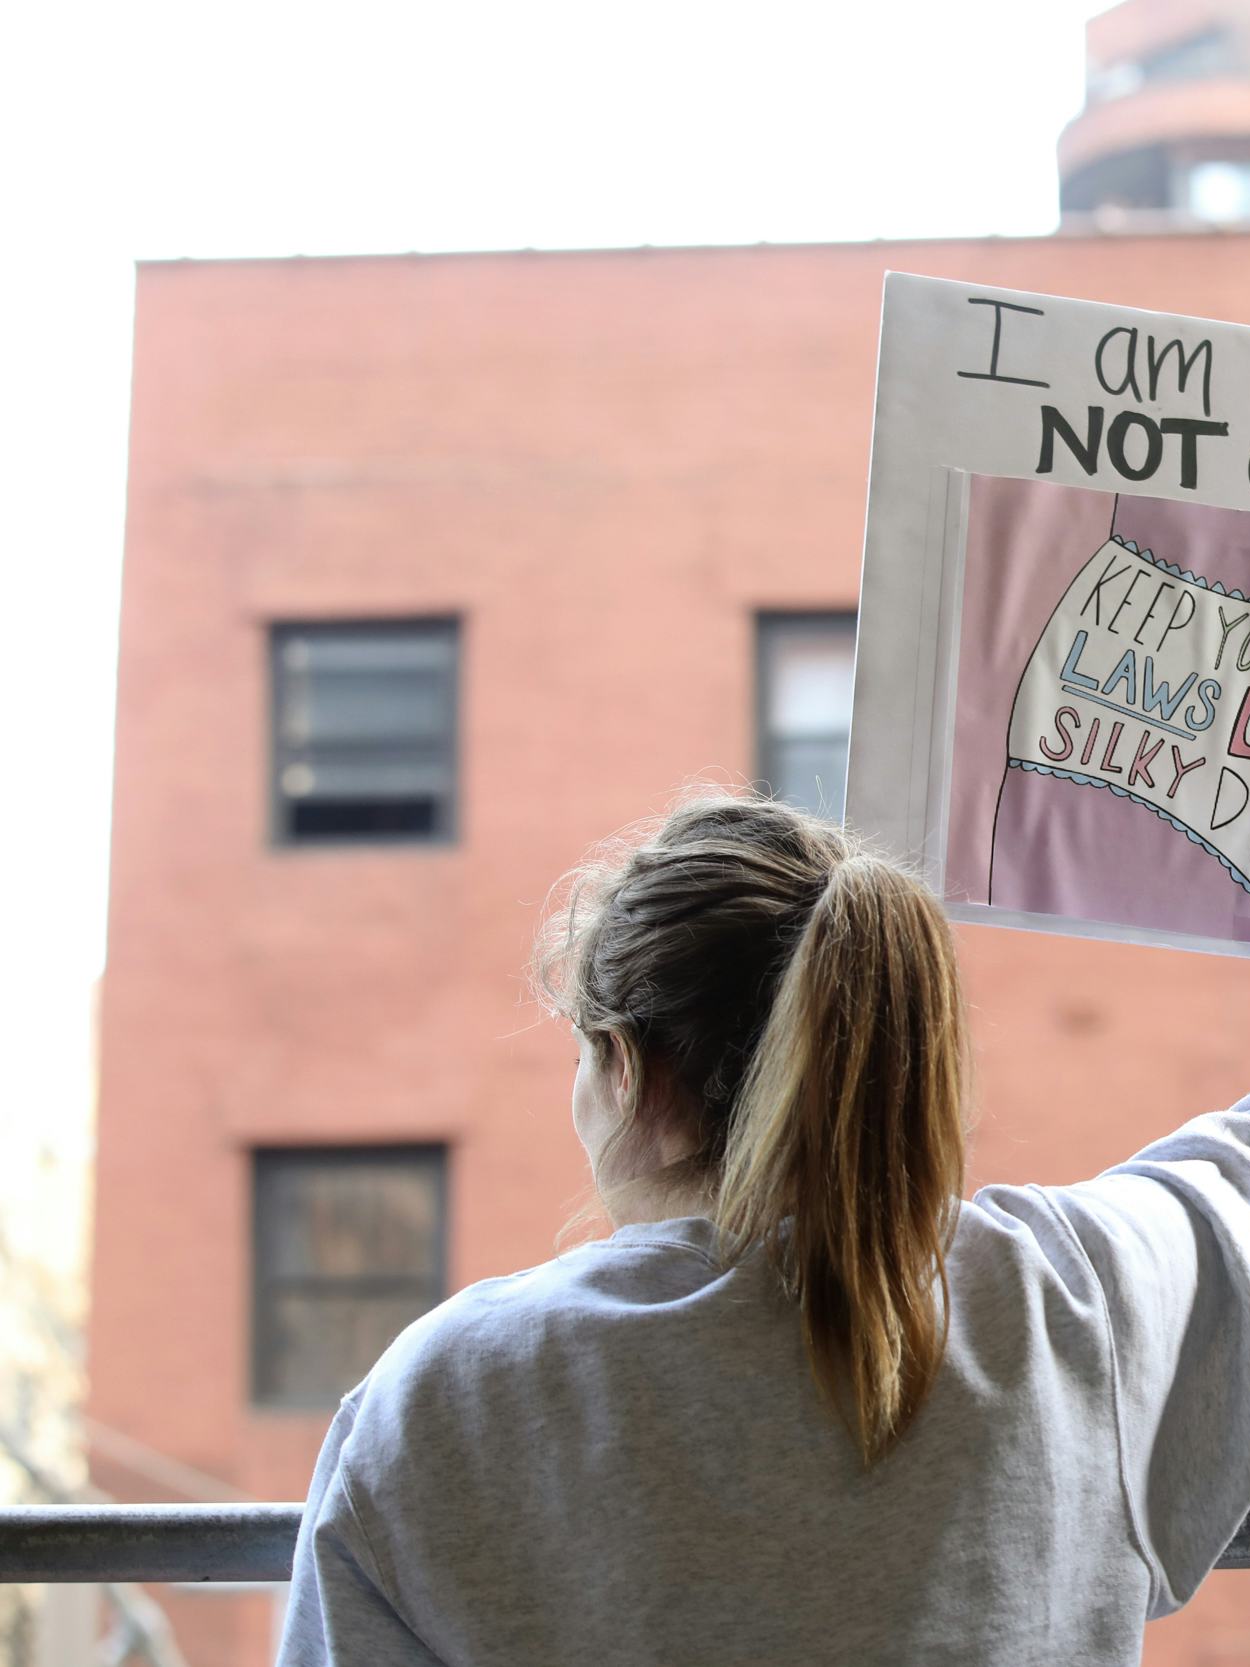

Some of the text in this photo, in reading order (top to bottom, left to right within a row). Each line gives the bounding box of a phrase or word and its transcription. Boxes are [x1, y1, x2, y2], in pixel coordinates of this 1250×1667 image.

[957, 297, 1050, 389] I
[1094, 325, 1213, 417] am
[1035, 404, 1230, 490] NOT
[1079, 554, 1197, 653] KEEP
[1060, 630, 1222, 732] LAWS
[1038, 705, 1207, 799] SILKY
